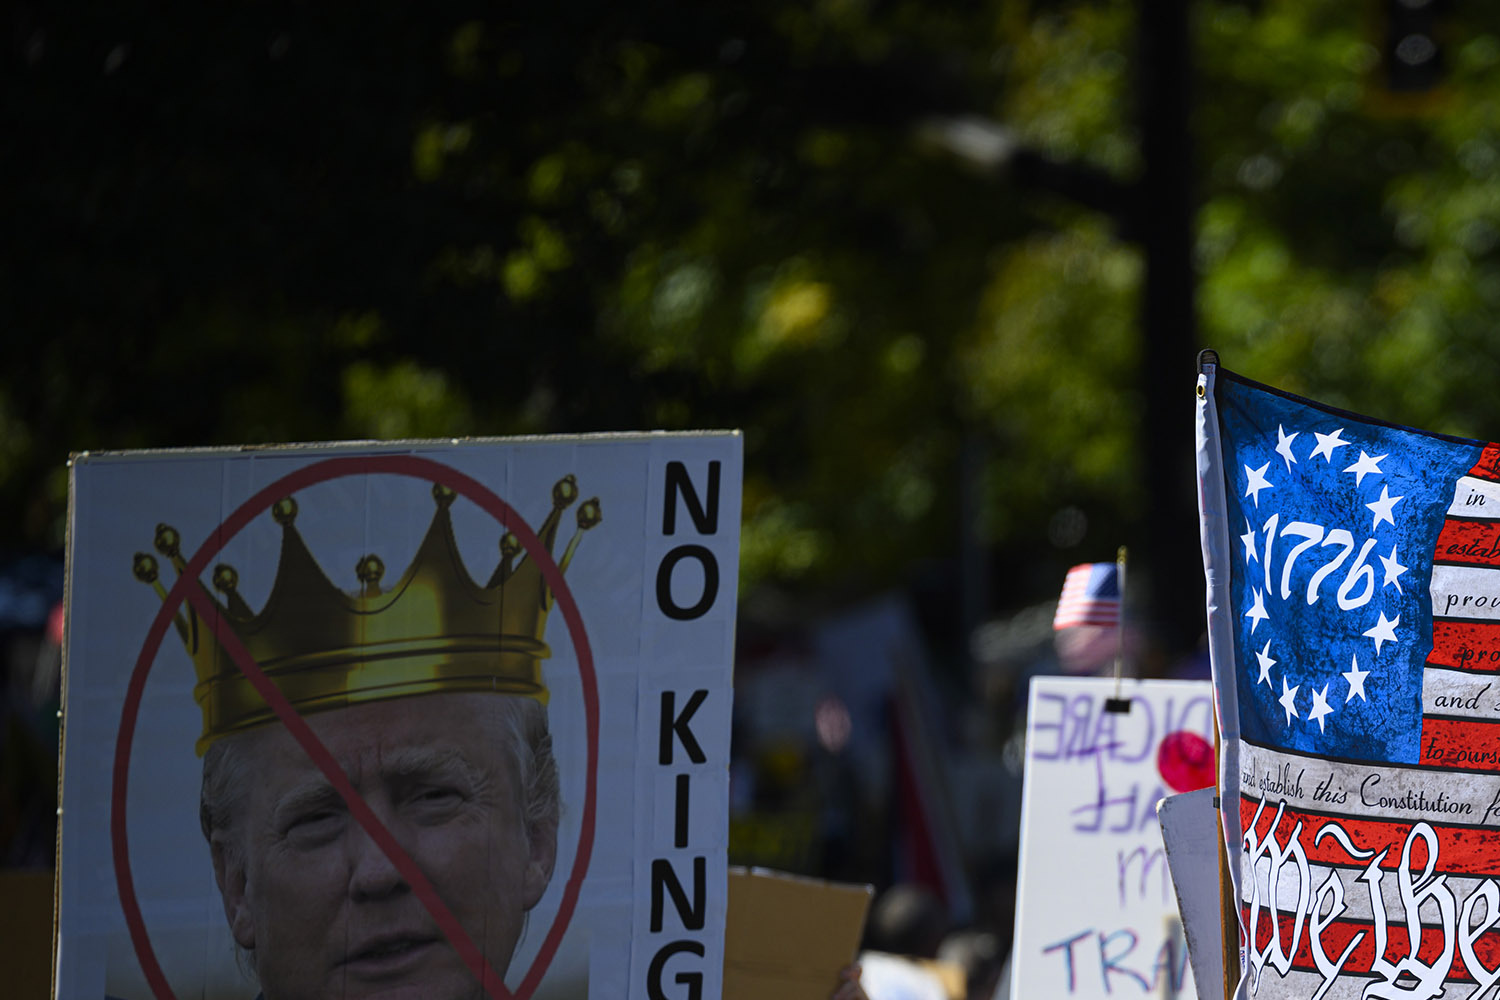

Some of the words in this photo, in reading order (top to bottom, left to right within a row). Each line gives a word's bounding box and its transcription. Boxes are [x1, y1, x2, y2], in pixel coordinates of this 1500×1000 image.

[1466, 488, 1486, 507] in
[655, 460, 722, 621] NO
[1262, 513, 1377, 611] 1776
[1434, 683, 1492, 711] and
[1425, 738, 1445, 761] to
[1259, 762, 1305, 800] establish
[1311, 773, 1349, 805] this
[1359, 772, 1474, 816] Constitution
